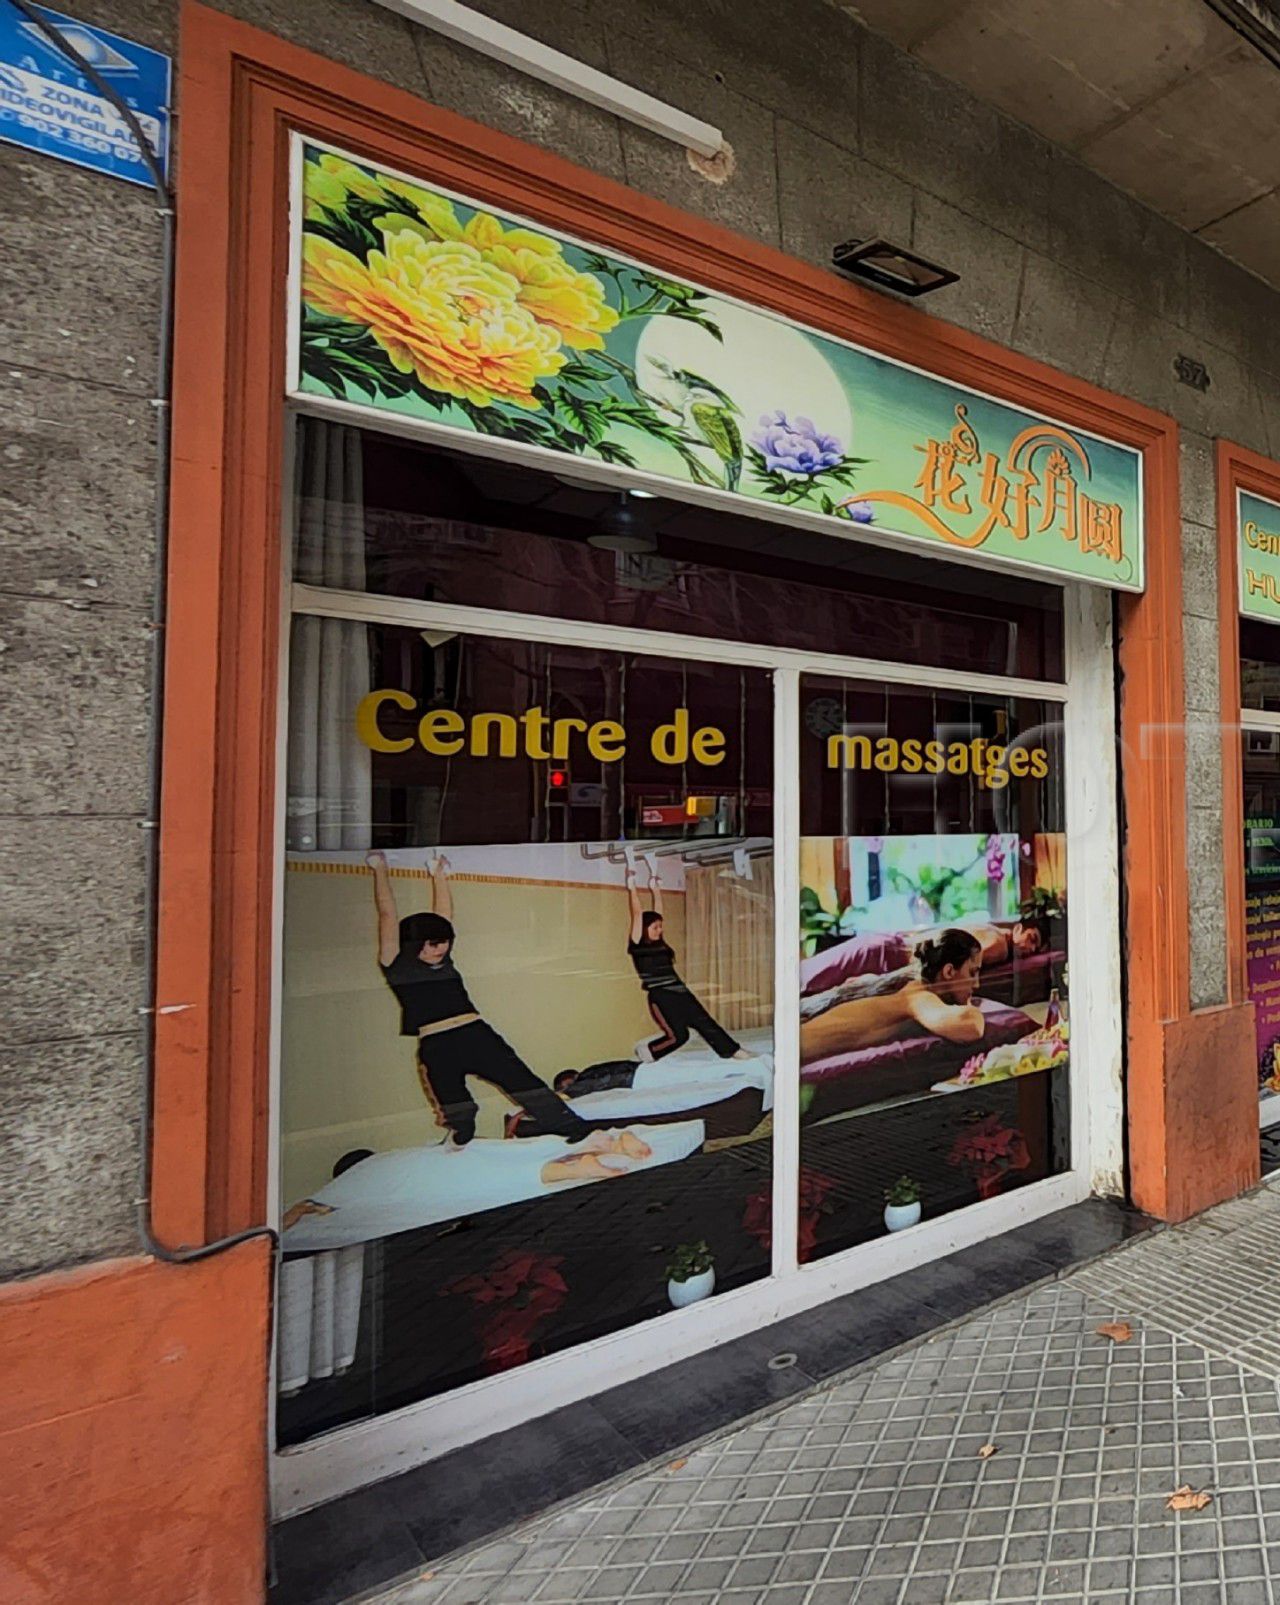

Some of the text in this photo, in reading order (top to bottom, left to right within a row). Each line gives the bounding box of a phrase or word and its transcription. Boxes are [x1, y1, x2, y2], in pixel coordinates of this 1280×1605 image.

[40, 84, 104, 118] ZONA
[114, 146, 149, 168] 07
[355, 688, 726, 766] Centre de
[827, 733, 1048, 789] massatges
